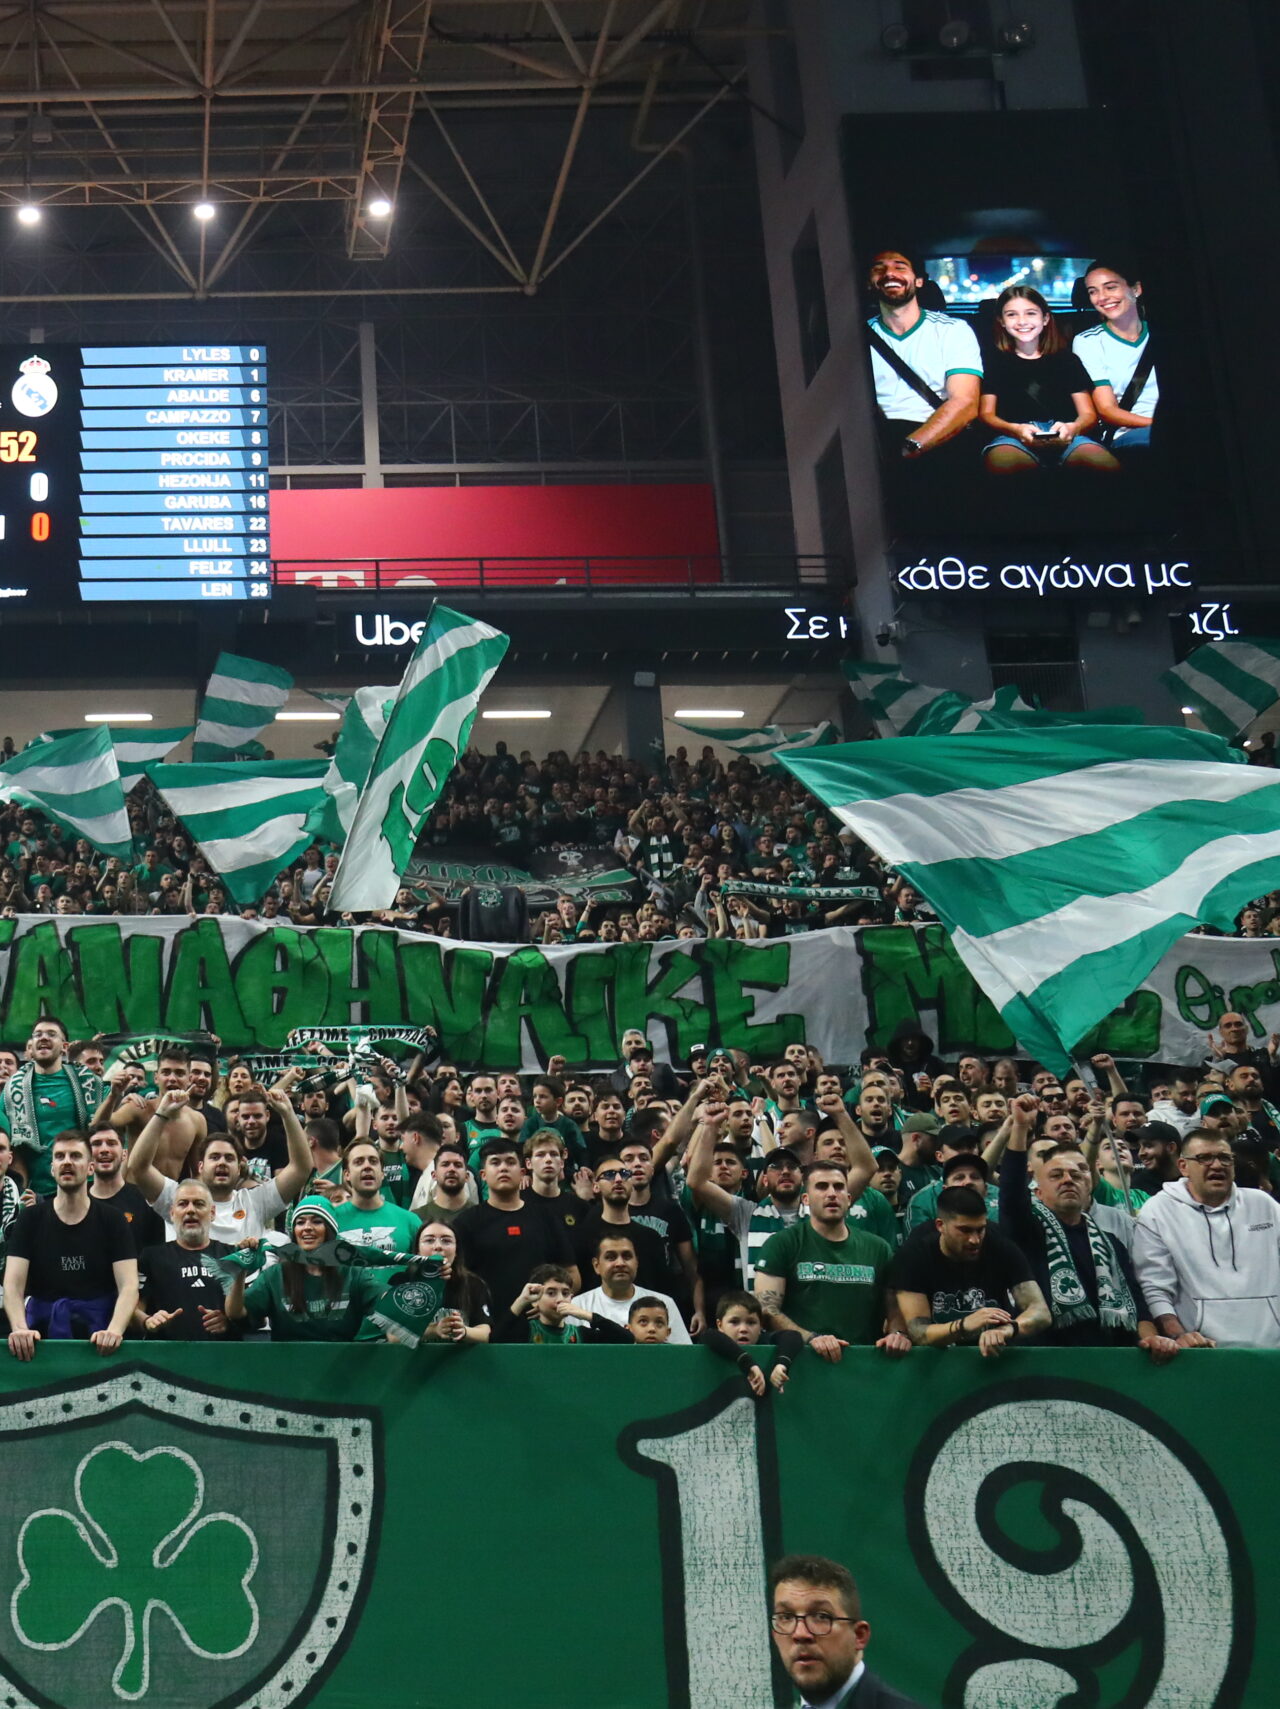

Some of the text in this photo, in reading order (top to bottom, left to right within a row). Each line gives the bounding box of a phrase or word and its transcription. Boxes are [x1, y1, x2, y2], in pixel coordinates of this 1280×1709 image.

[182, 348, 259, 362] LYLES 0
[163, 368, 258, 382] KRAMER 1
[167, 389, 260, 403] ABALDE 6
[145, 409, 260, 424] CAMPAZZO 7
[176, 431, 261, 445] OKEKE 8
[161, 452, 262, 466] PROCIDA 9
[30, 472, 49, 502] 0
[158, 474, 265, 488] HEZONJA 11
[164, 495, 266, 510] GARUBA 16
[31, 512, 50, 542] 0
[161, 516, 266, 531] TAVARES 22
[183, 539, 267, 553] LLULL 23
[189, 560, 268, 575] FELIZ 24
[1000, 557, 1136, 596] αγώνα
[201, 582, 268, 597] LEN 25
[355, 614, 426, 645] Ube
[784, 608, 830, 639] Σε
[369, 1026, 429, 1048] CONTRAC
[61, 1256, 84, 1264] FAKE
[181, 1266, 199, 1278] PAO
